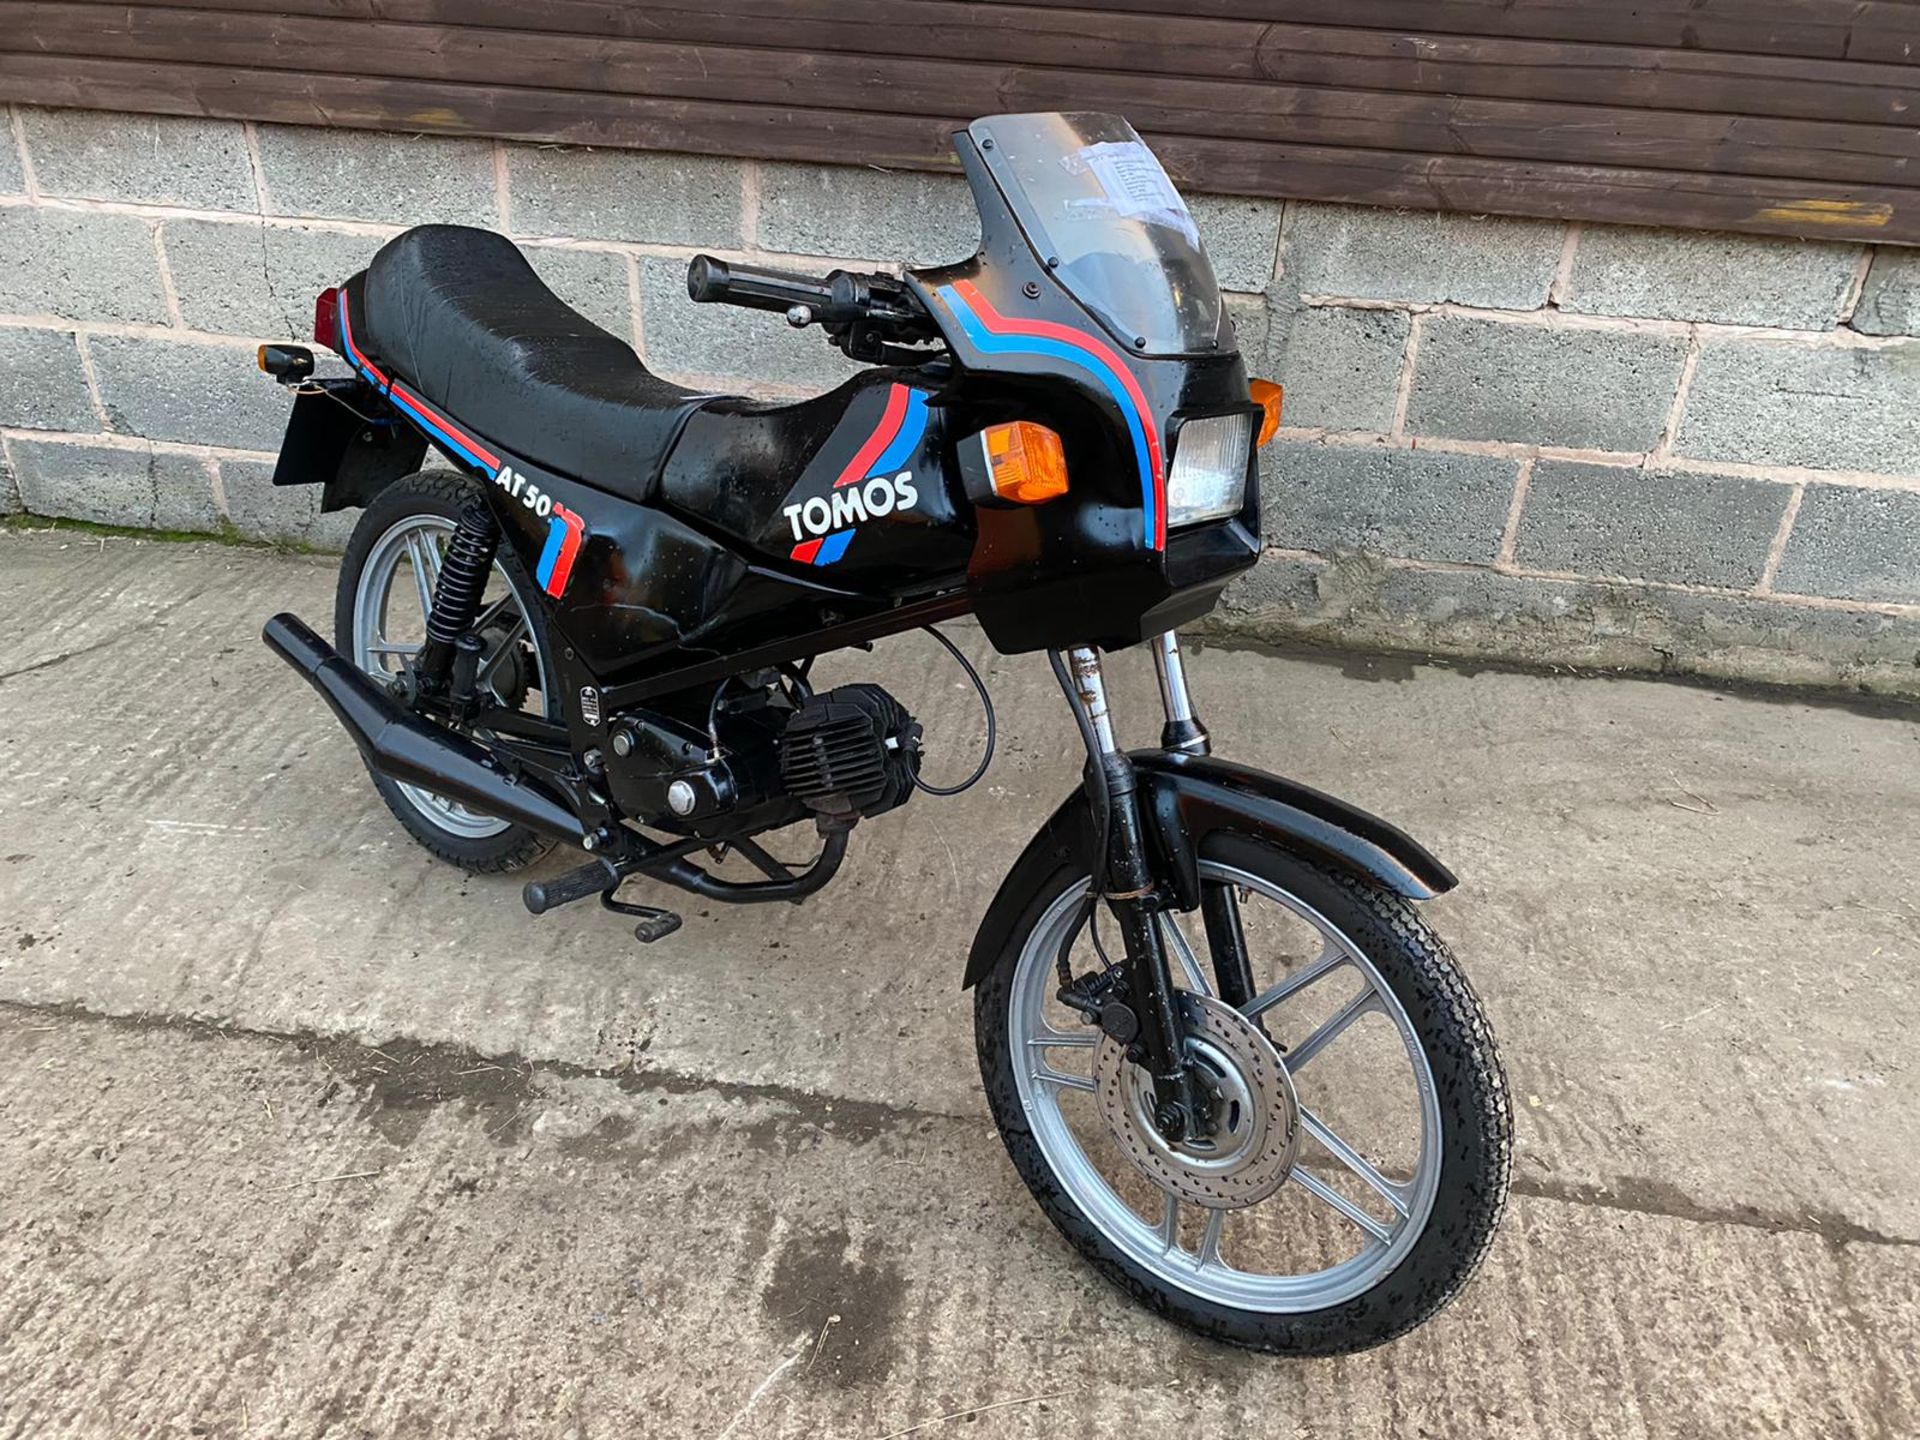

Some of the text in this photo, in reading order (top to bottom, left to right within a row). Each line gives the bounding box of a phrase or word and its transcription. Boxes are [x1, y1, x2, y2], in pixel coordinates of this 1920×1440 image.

[495, 466, 552, 517] AT 50
[783, 470, 919, 542] TOMOS
